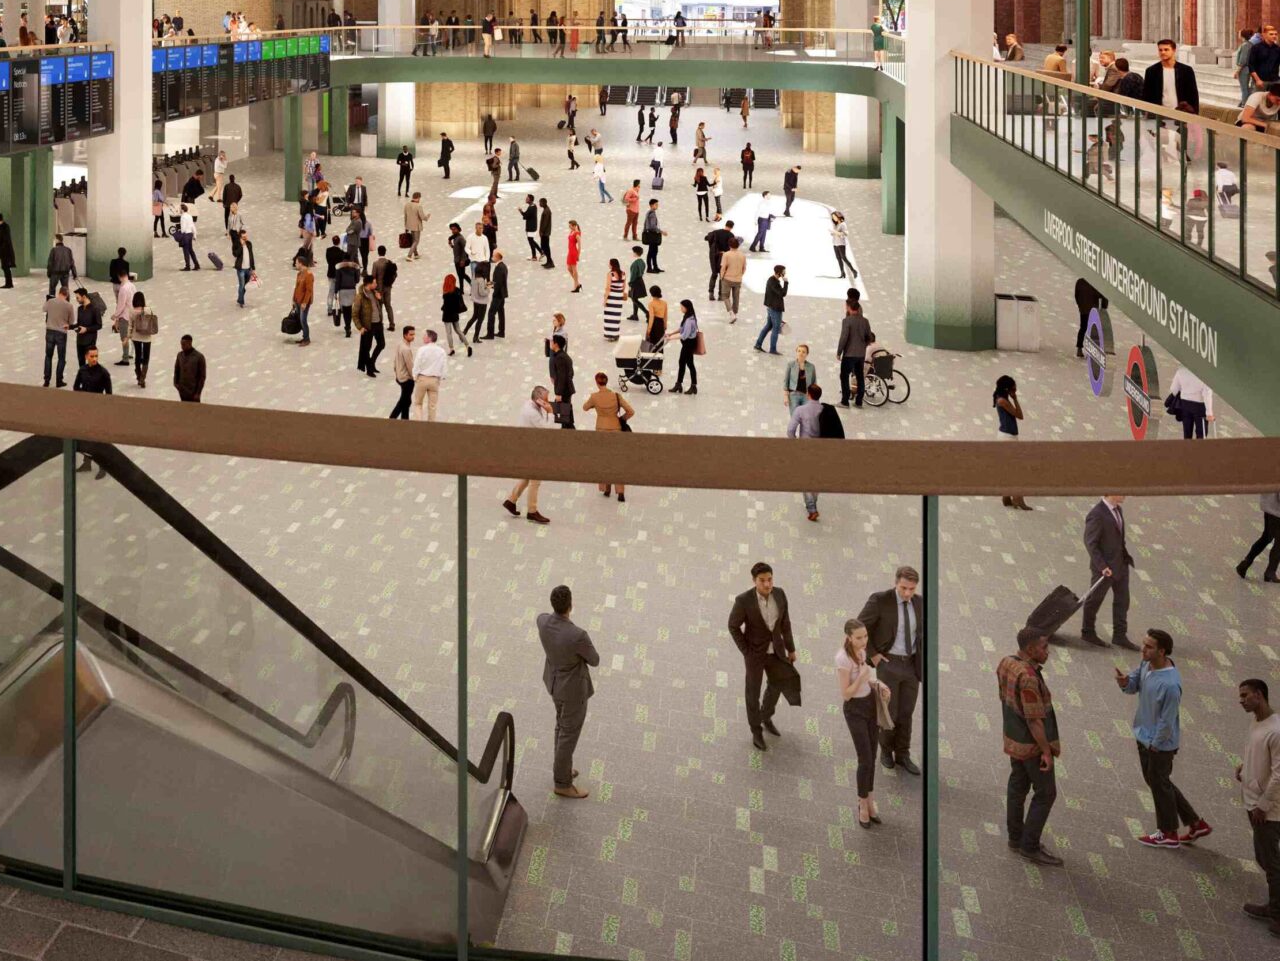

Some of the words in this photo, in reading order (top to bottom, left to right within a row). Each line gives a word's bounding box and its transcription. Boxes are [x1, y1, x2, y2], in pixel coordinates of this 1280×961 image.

[13, 67, 27, 76] Special
[1044, 207, 1075, 255] LIVERPOOL
[1075, 231, 1101, 275] STREET
[1101, 249, 1168, 327] UNDERGROUND
[1169, 299, 1218, 368] STATION
